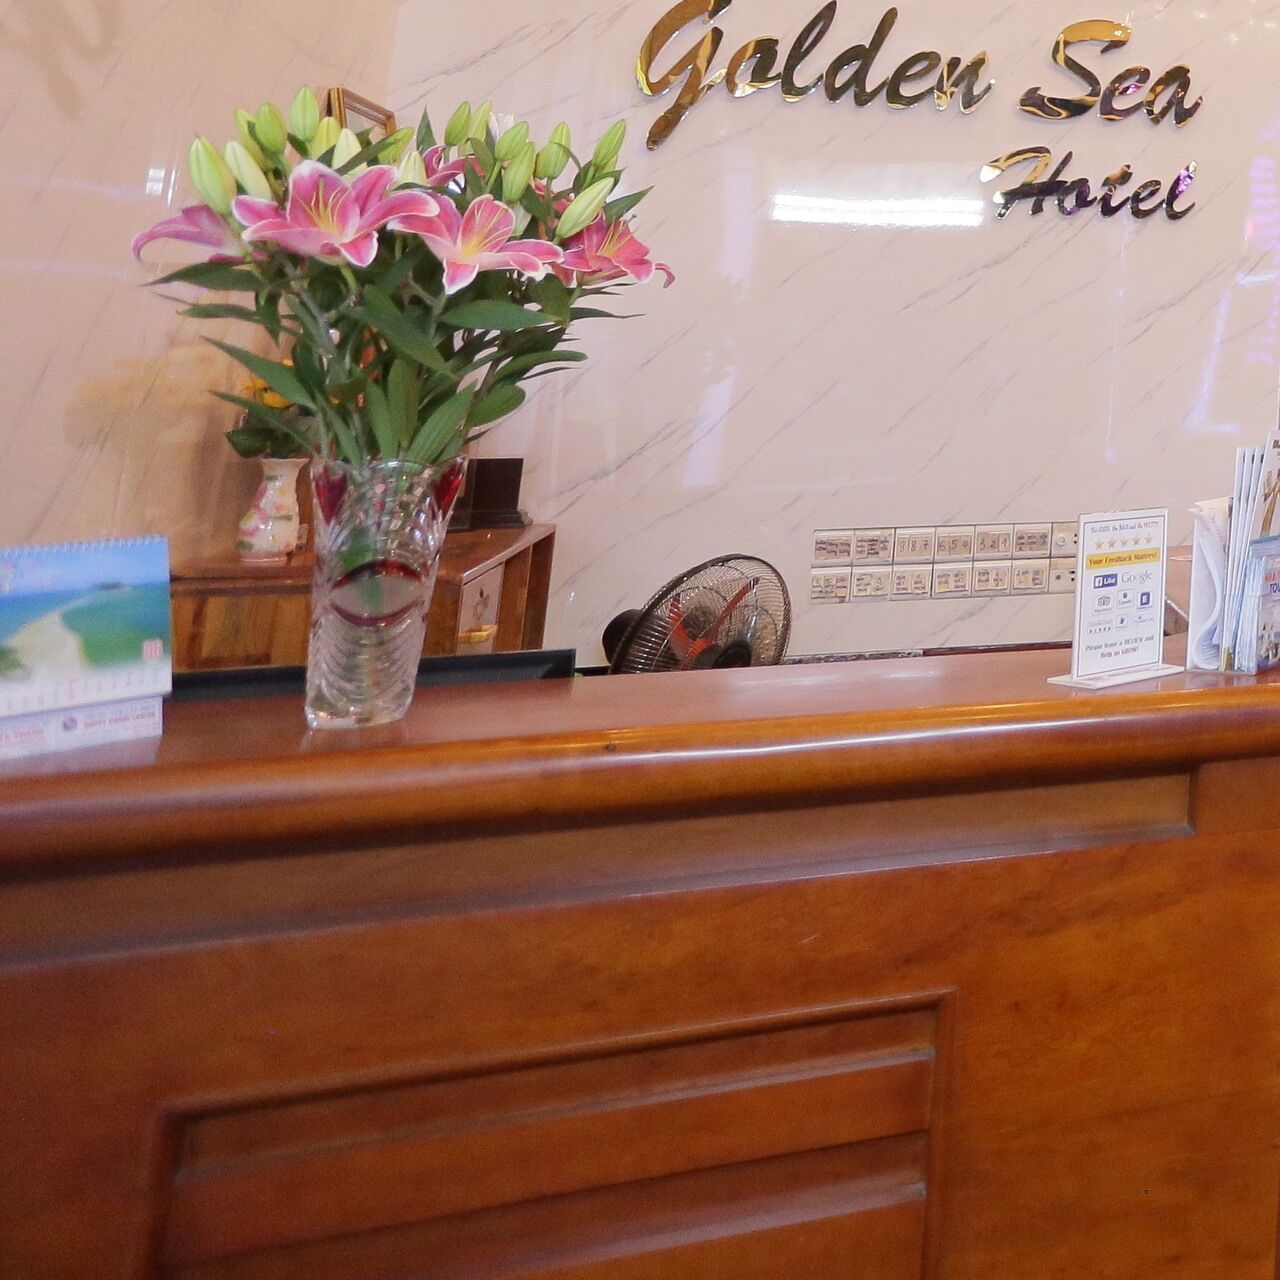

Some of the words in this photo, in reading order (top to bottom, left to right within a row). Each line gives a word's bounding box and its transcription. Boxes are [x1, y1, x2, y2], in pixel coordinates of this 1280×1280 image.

[1019, 19, 1203, 127] Sea
[979, 145, 1197, 220] Hotel
[1121, 570, 1152, 584] Google
